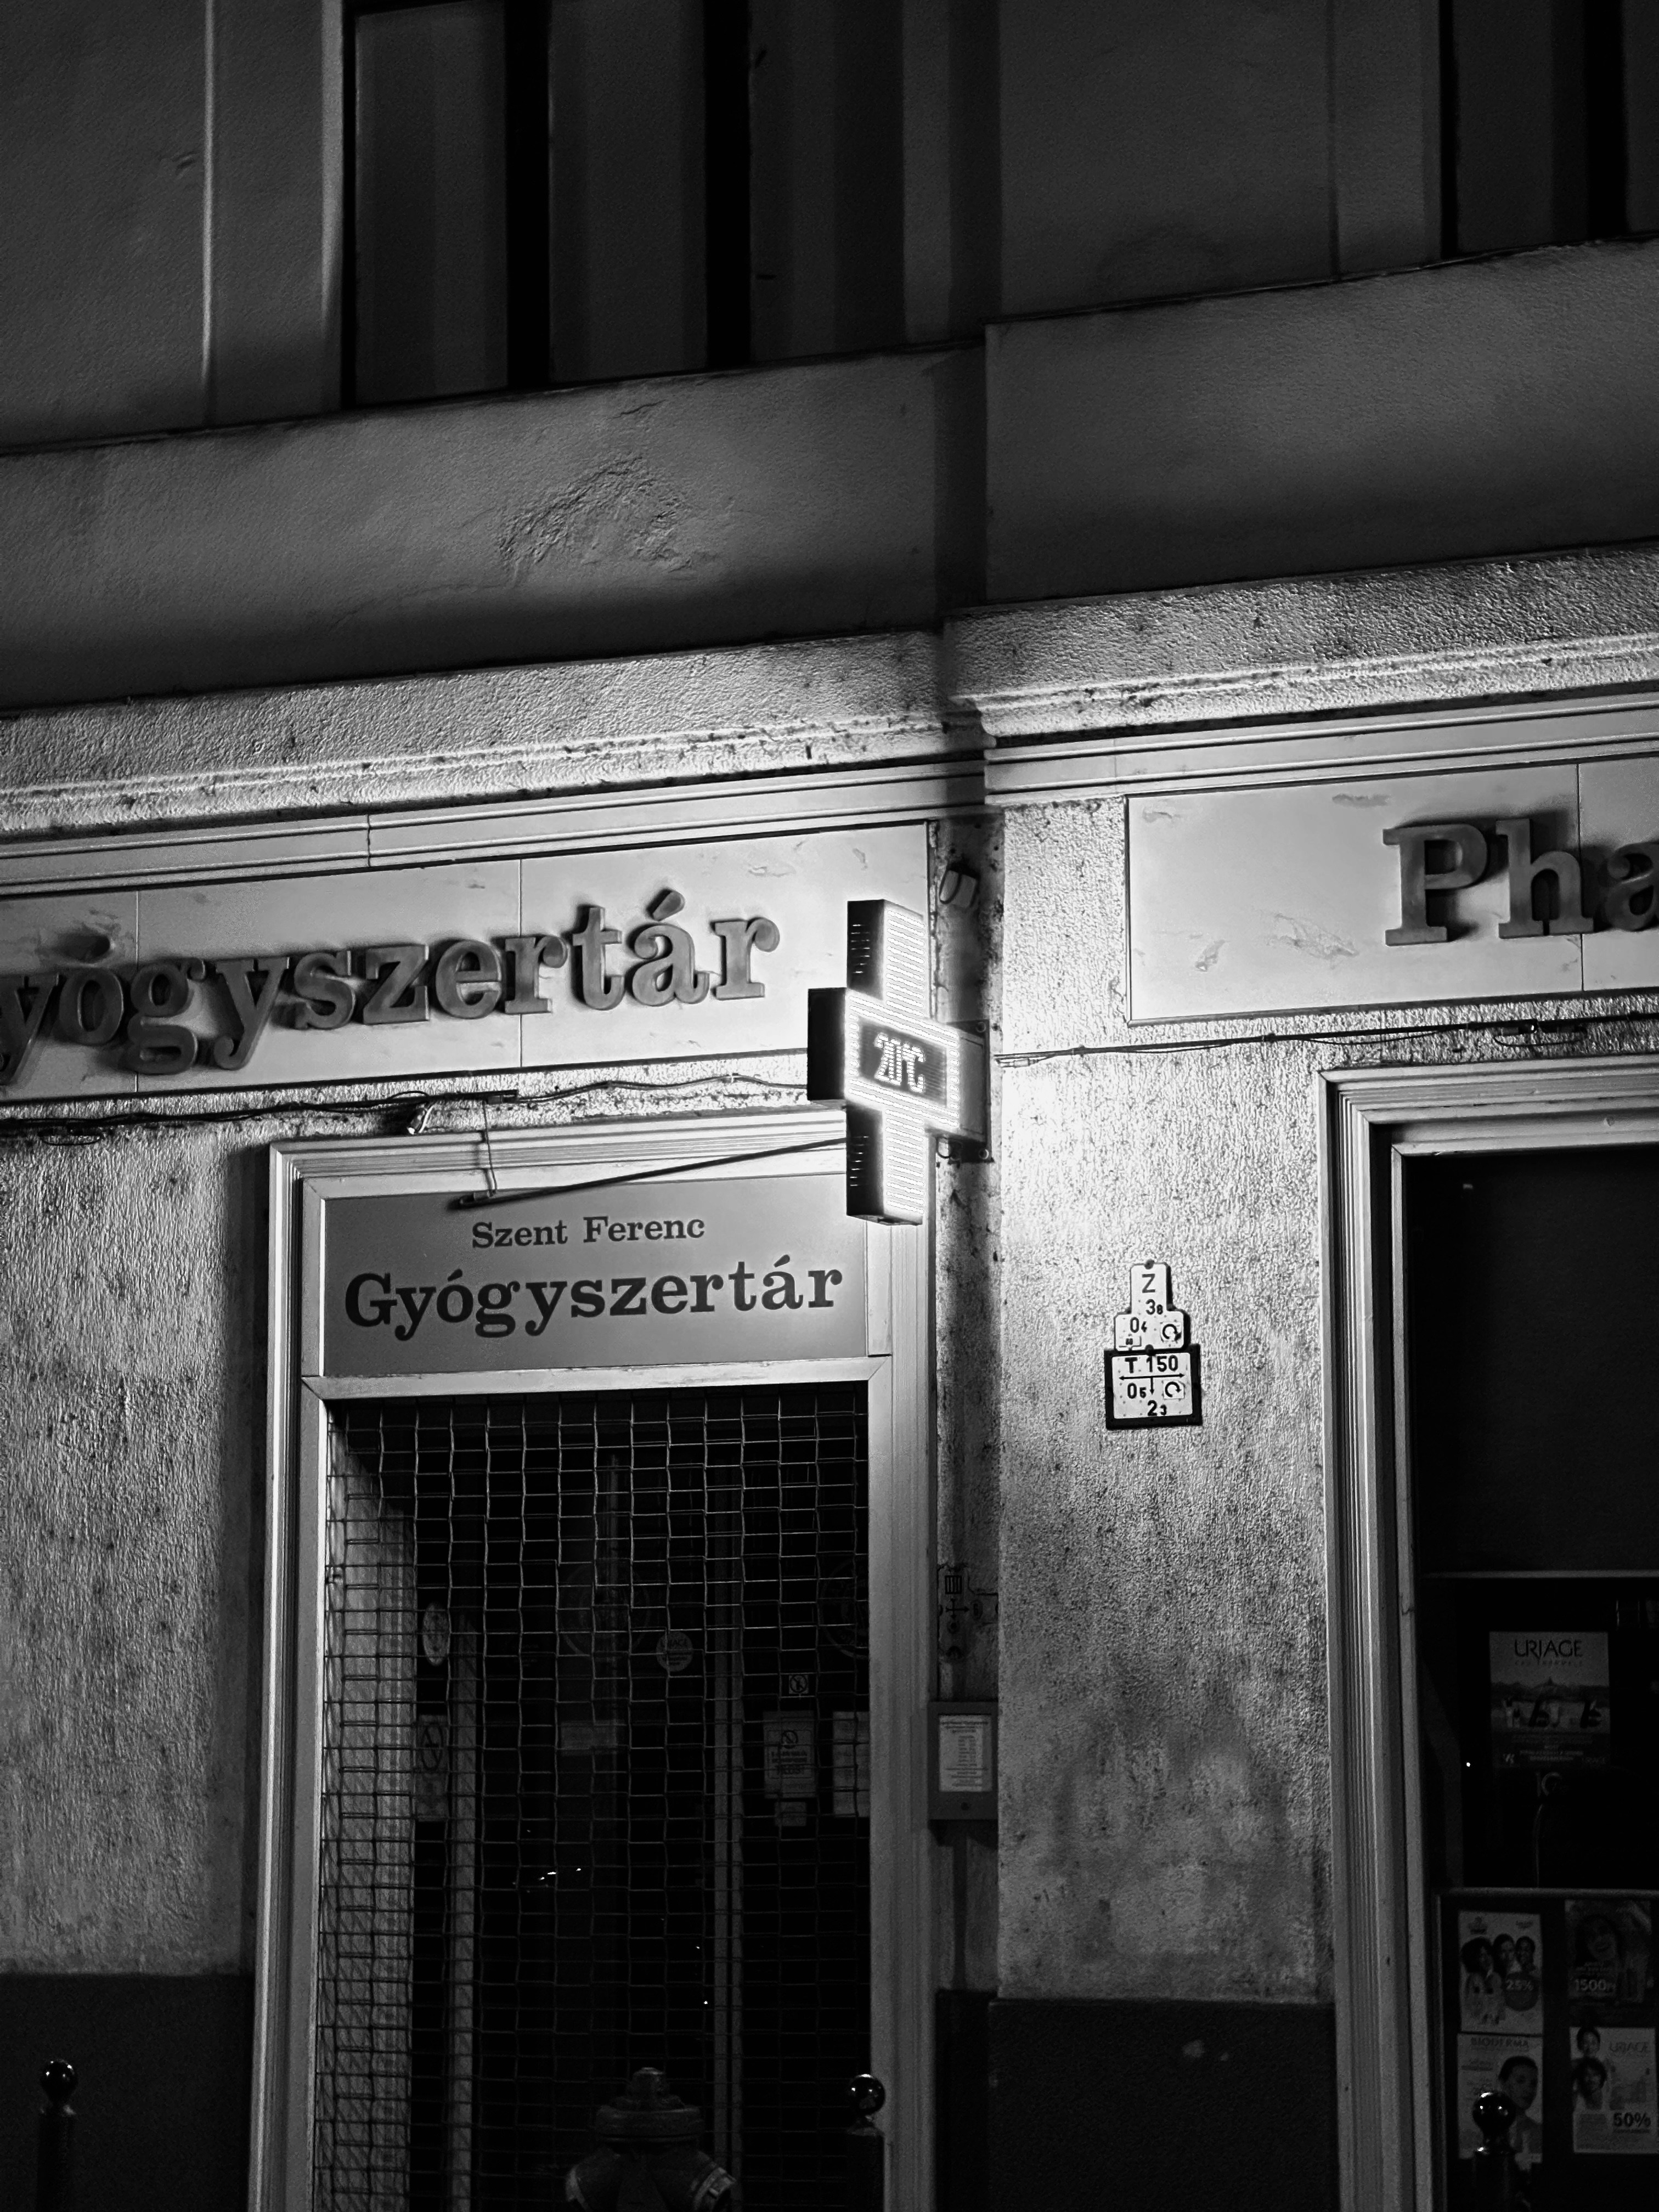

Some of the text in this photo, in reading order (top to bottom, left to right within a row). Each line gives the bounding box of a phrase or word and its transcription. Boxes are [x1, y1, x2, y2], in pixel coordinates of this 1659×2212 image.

[1382, 817, 1659, 946] Pha
[471, 1215, 705, 1249] Szent Ferenc
[1142, 1273, 1156, 1294] Z
[344, 1254, 843, 1341] Gyógyszertár
[1125, 1355, 1178, 1374] T 150
[1514, 1639, 1583, 1659] URIAGE
[1613, 2112, 1651, 2128] 50%
